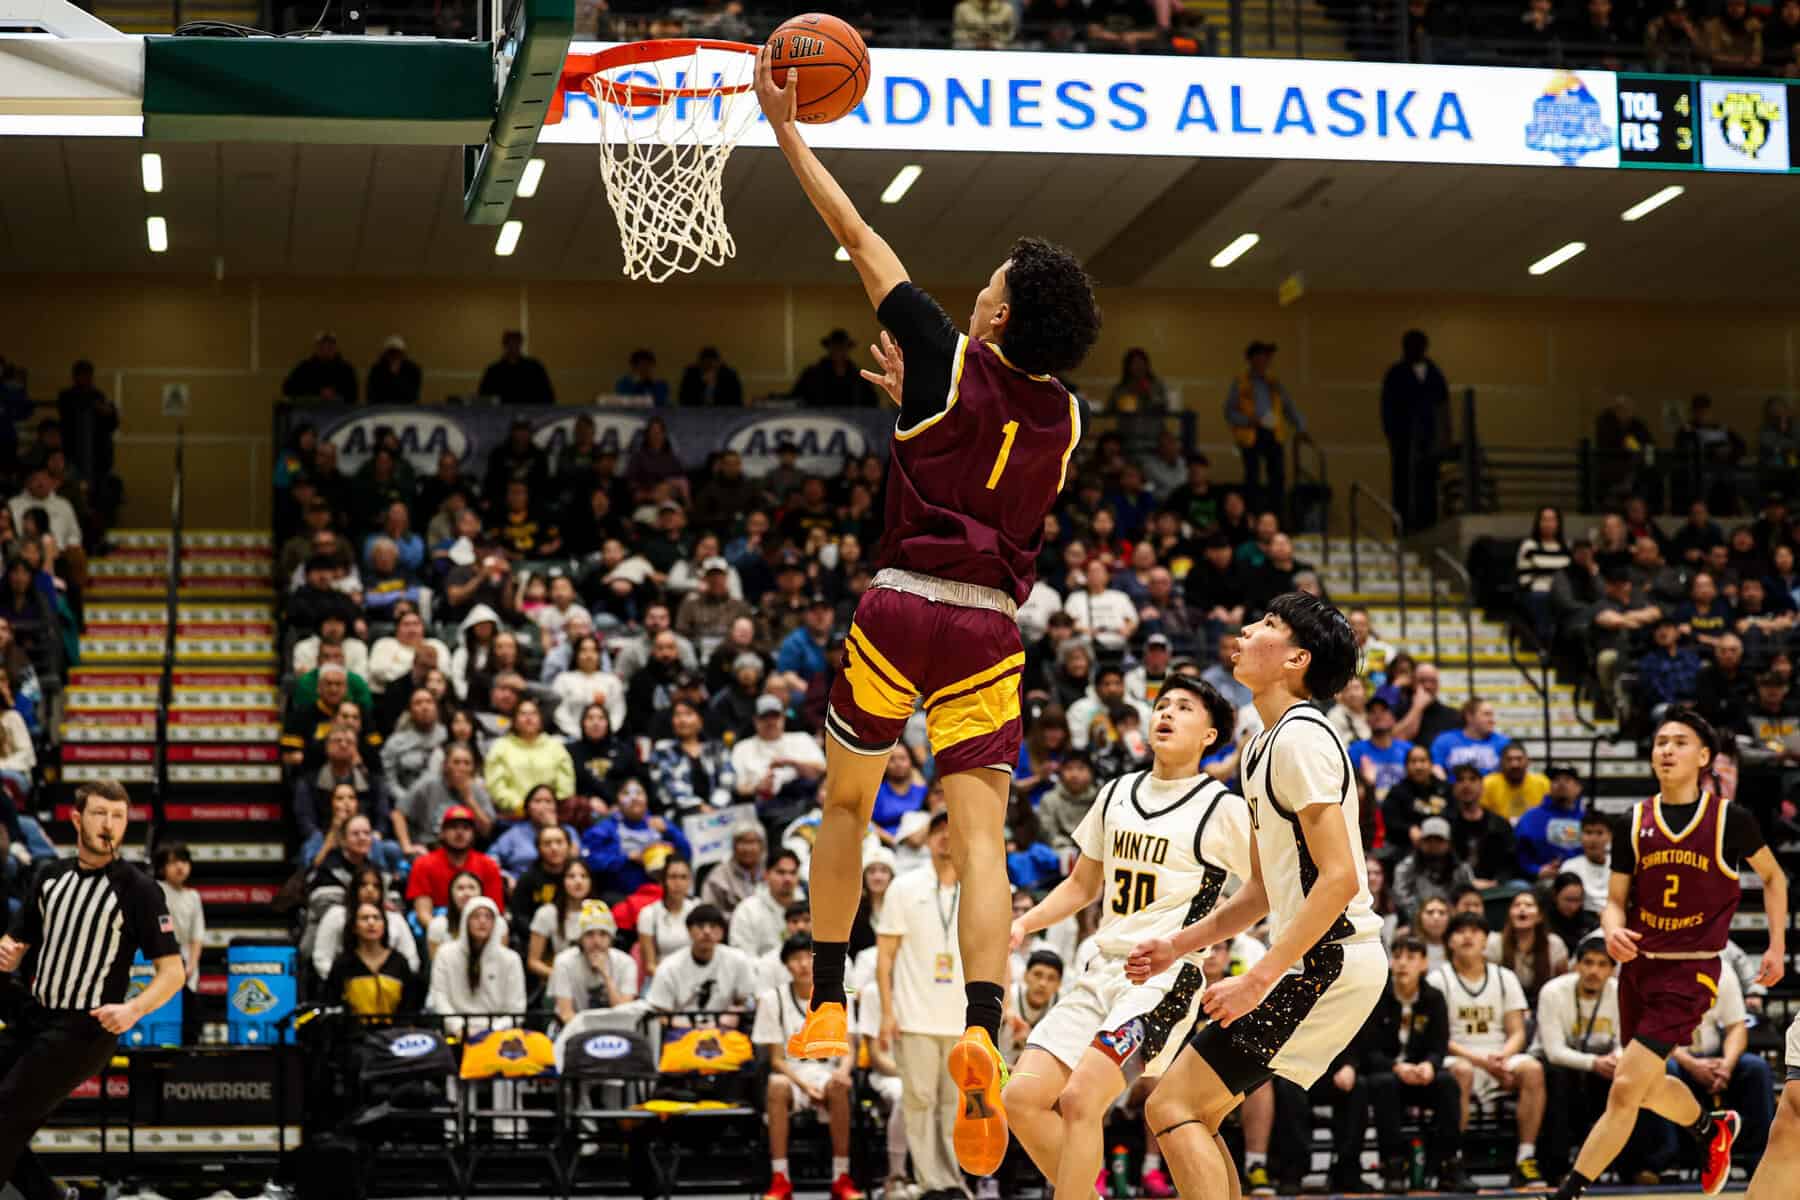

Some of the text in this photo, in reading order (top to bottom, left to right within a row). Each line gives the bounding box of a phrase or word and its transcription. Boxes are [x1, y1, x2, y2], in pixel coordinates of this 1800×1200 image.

[790, 35, 824, 58] THE
[1175, 84, 1473, 140] ALASKA
[1620, 92, 1663, 121] TOL
[1673, 94, 1690, 117] 4
[1620, 122, 1660, 151] FLS
[1675, 127, 1692, 150] 3
[343, 425, 454, 455] AAA
[985, 420, 1019, 490] 1
[1112, 830, 1169, 865] MINTO
[1111, 868, 1157, 916] 30
[1663, 874, 1680, 908] 2
[163, 1082, 272, 1101] POWERADE
